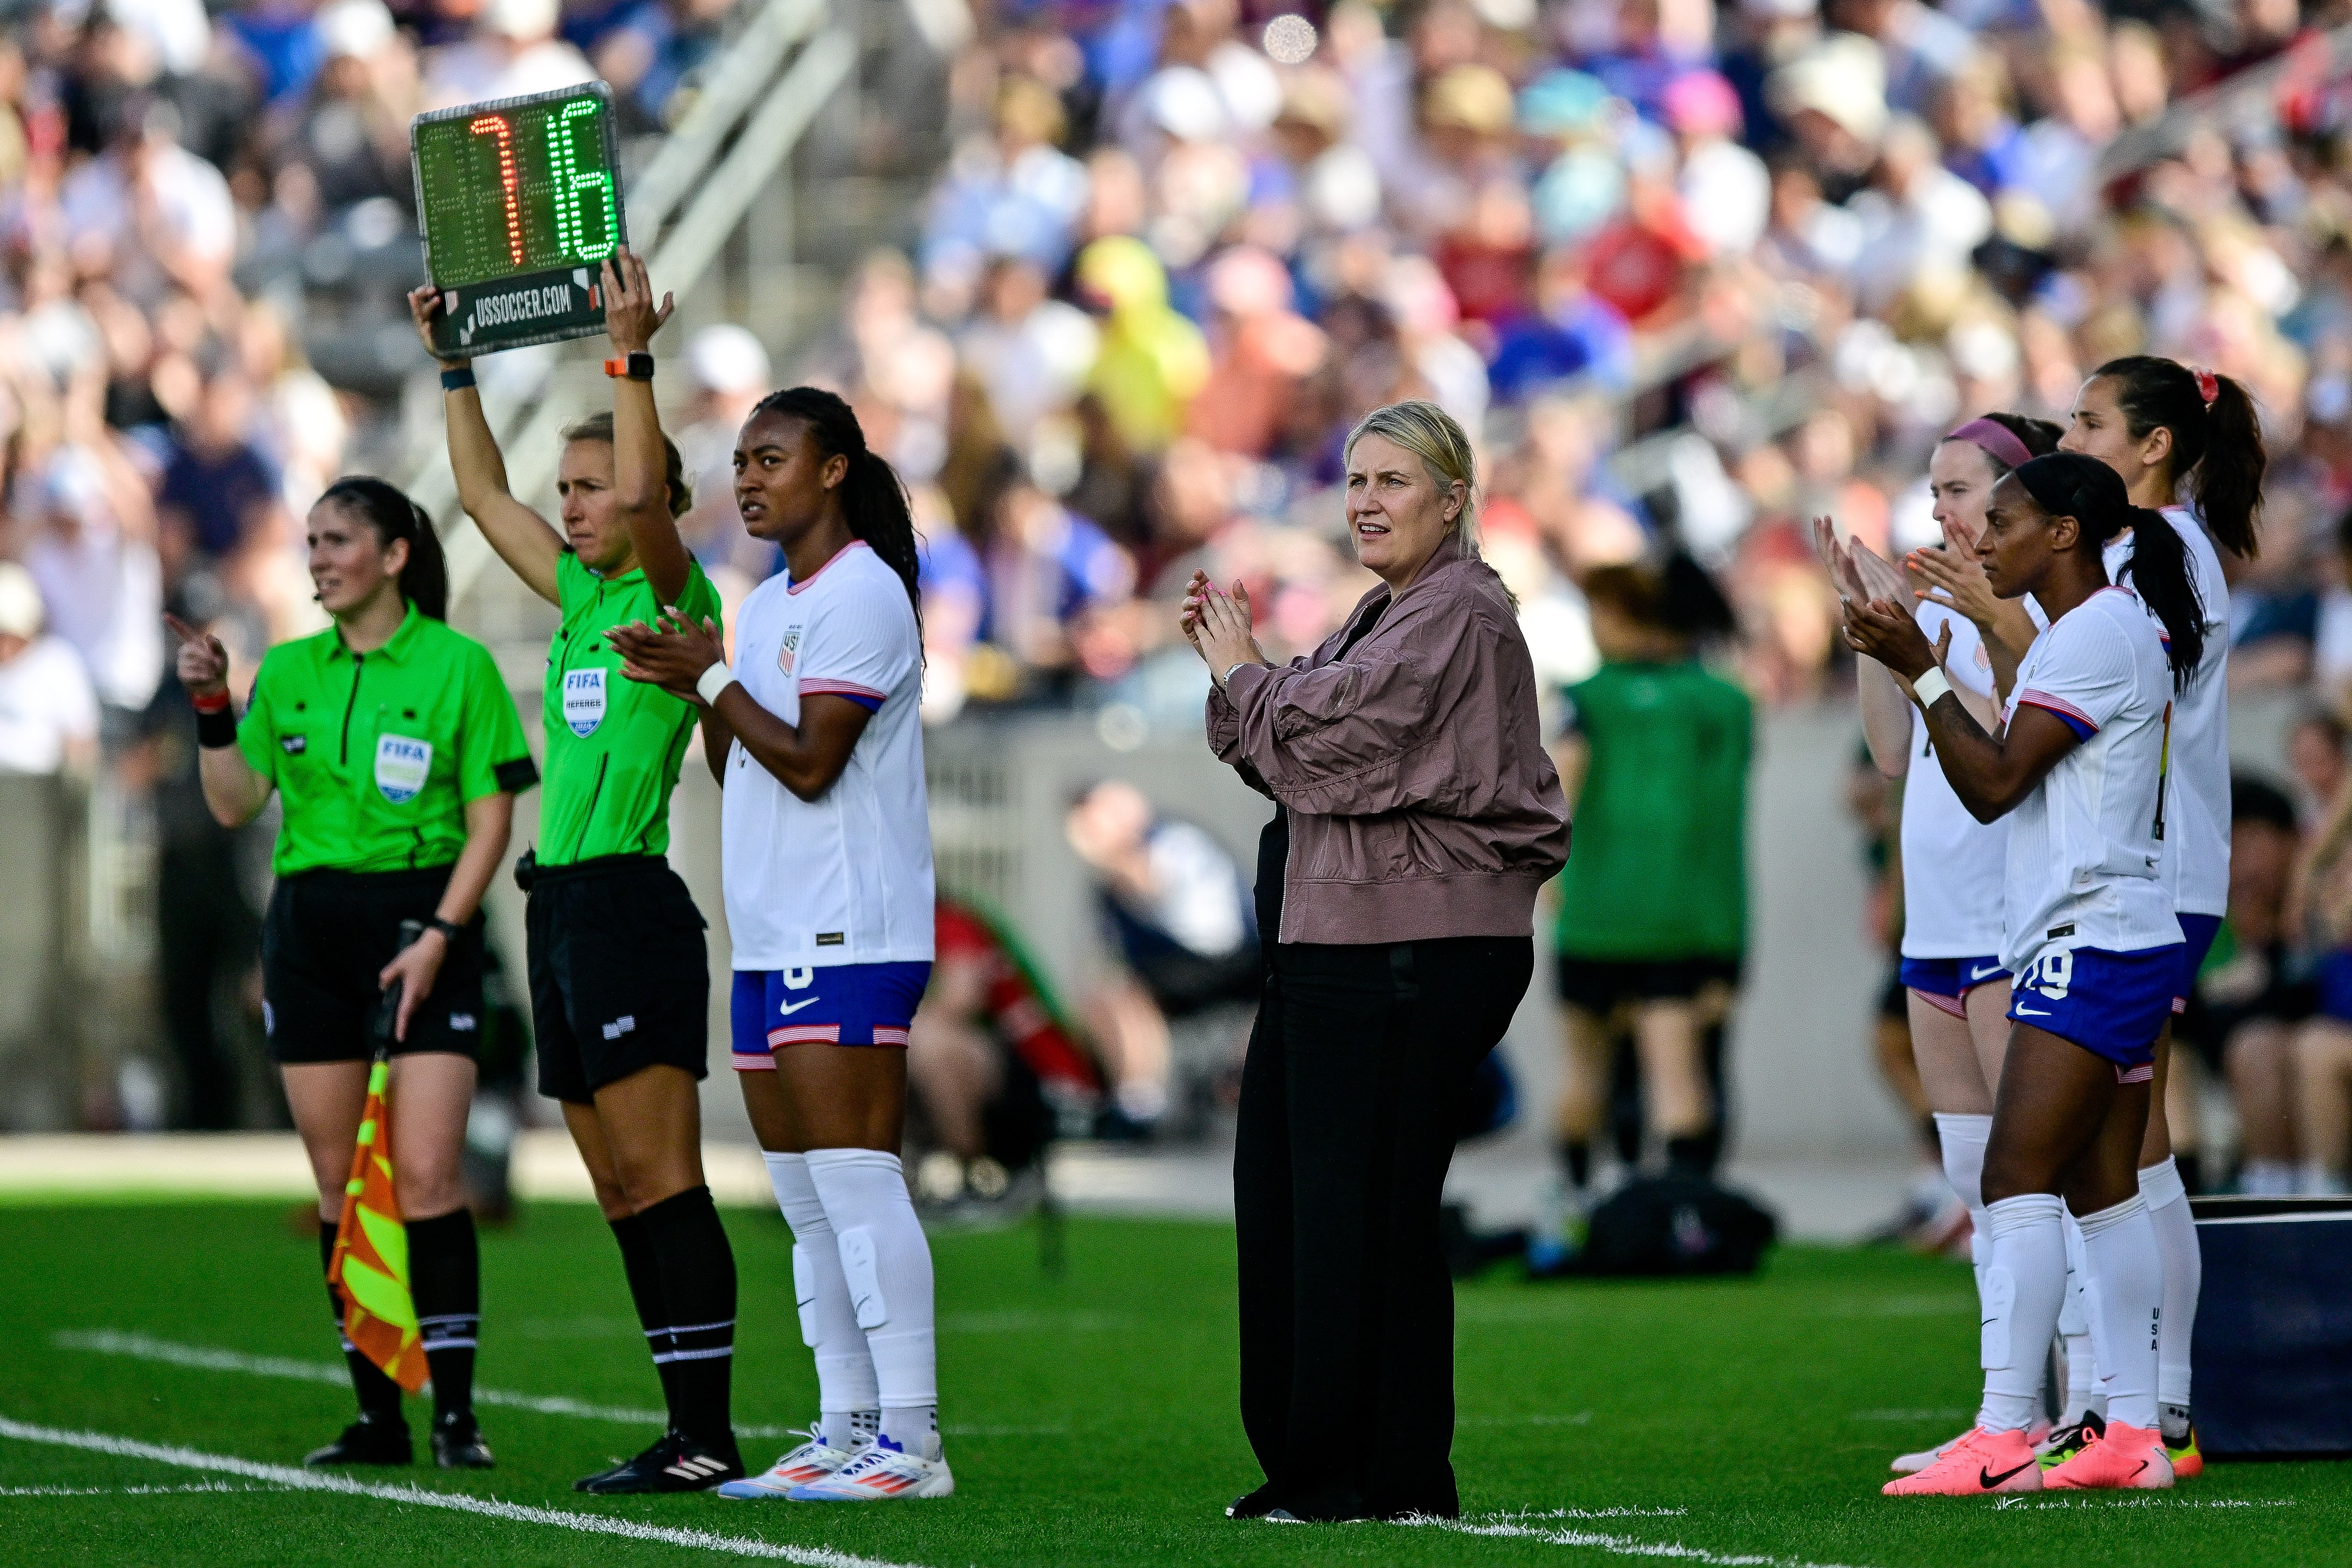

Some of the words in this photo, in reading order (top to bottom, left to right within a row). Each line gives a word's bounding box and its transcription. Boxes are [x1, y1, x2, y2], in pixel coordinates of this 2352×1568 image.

[470, 115, 522, 266] 7
[547, 100, 618, 260] 16
[476, 283, 572, 327] USSOCCER.COM
[567, 673, 600, 689] FIFA
[566, 699, 601, 709] REFEREE
[383, 741, 424, 761] FIFA
[2151, 1307, 2160, 1351] USA
